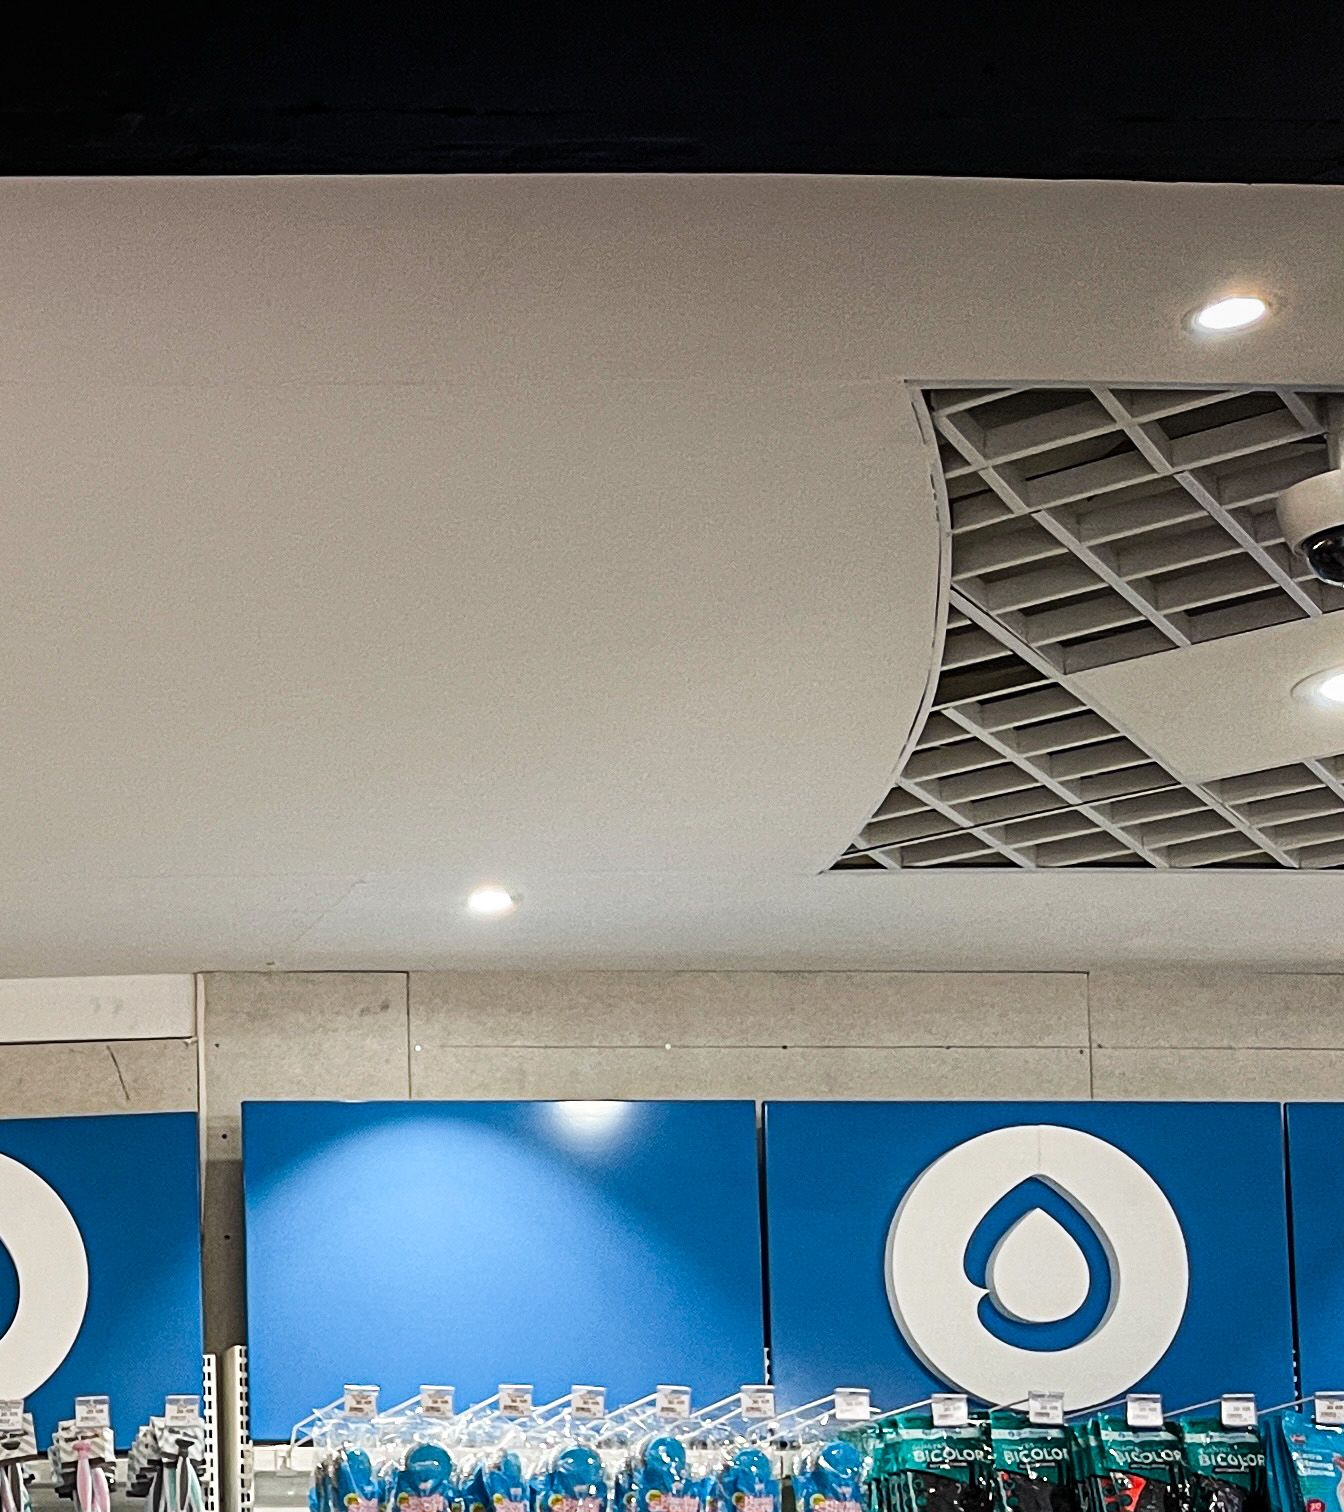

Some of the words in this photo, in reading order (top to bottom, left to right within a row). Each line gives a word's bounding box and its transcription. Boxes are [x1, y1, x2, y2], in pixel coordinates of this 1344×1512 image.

[914, 1449, 984, 1462] BICOLOR
[1004, 1448, 1068, 1463] BICOLO
[1199, 1453, 1265, 1467] BICOLOR
